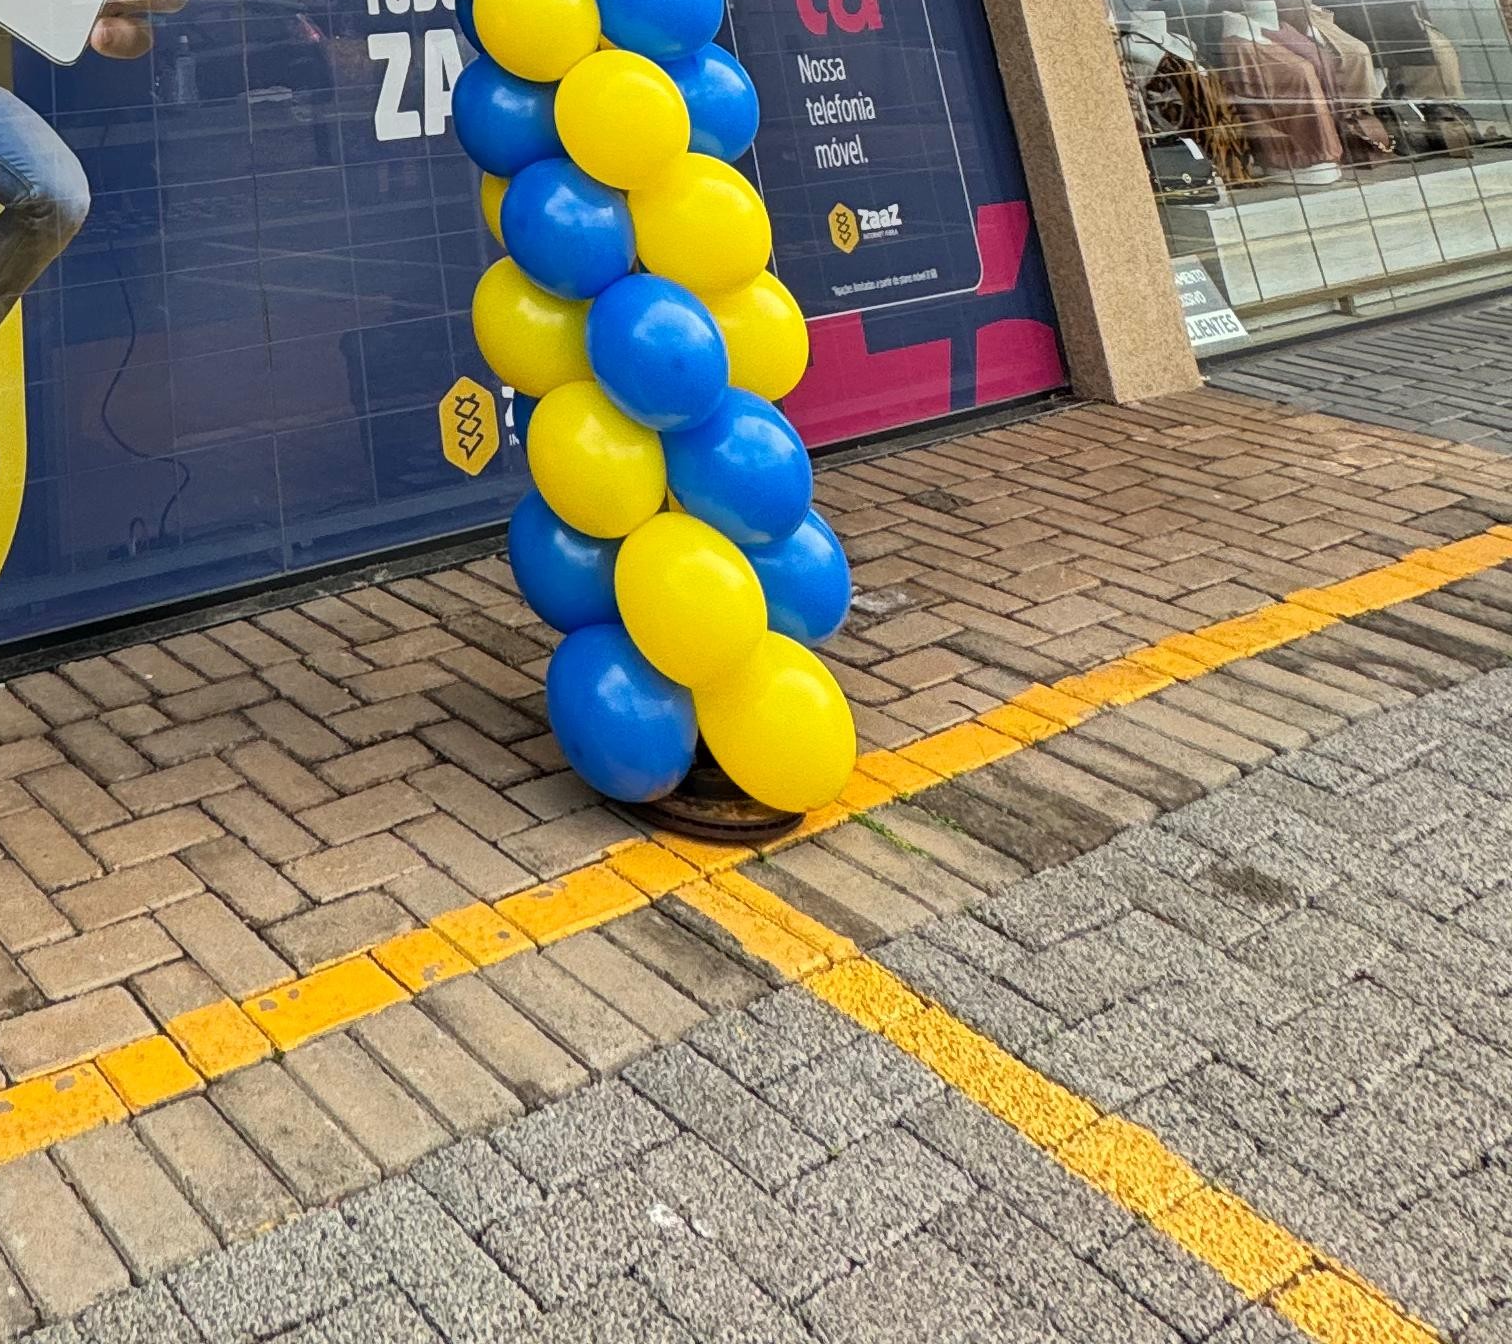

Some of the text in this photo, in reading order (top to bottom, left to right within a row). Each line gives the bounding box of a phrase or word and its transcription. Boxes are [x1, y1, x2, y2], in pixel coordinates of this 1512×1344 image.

[796, 53, 847, 84] Nossa
[805, 90, 876, 126] telefonia
[814, 133, 869, 169] móvel.
